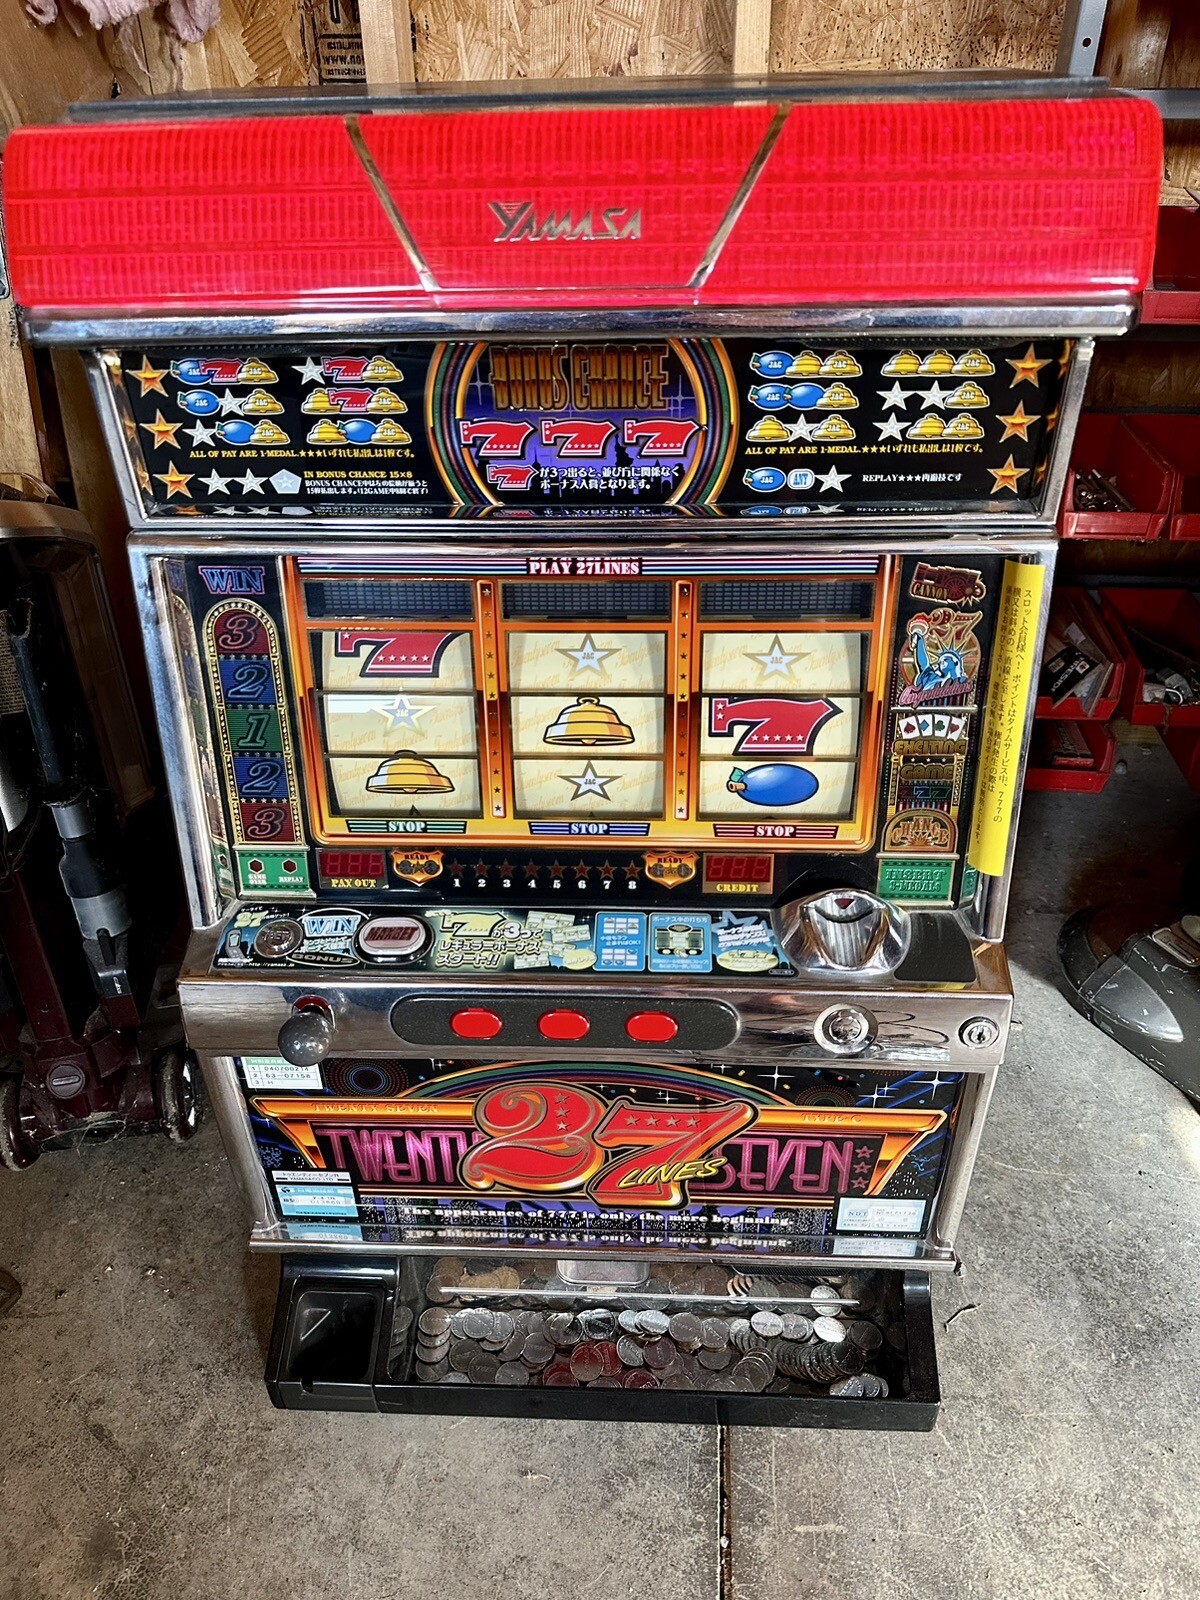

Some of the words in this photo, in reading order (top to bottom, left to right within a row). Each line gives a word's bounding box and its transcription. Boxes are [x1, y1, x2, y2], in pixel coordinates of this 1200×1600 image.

[487, 201, 643, 242] YAMASA
[768, 359, 783, 368] JAC
[833, 359, 848, 368] JAC
[966, 358, 981, 367] JAC
[249, 367, 262, 375] JAC
[374, 366, 388, 375] JAC
[490, 345, 568, 411] BONUS
[571, 345, 669, 411] CHANCE
[378, 397, 392, 406] JAC
[766, 393, 780, 401] JAC
[830, 392, 844, 401] JAC
[961, 392, 975, 400] JAC
[195, 398, 208, 407] JAC
[255, 398, 269, 407] JAC
[261, 429, 275, 437] JAC
[383, 428, 397, 437] JAC
[827, 424, 842, 432] JAC
[956, 423, 971, 432] JAC
[189, 450, 206, 458] ALL
[208, 450, 219, 458] OF
[221, 450, 237, 458] PAY
[240, 450, 259, 458] ARE
[744, 444, 763, 455] ALL
[766, 445, 778, 455] OF
[779, 445, 796, 454] PAY
[797, 445, 818, 454] ARE
[316, 471, 346, 479] BONUS
[349, 471, 387, 479] CHANCE
[760, 475, 774, 484] JAC
[793, 473, 808, 486] ANY
[862, 474, 898, 482] REPLAY
[529, 562, 572, 575] PLAY
[575, 562, 640, 575] 27LINES
[198, 565, 266, 594] WIN
[912, 582, 950, 600] CANNON
[930, 608, 983, 641] 27
[218, 613, 259, 651] 3
[227, 663, 268, 699] 2
[237, 713, 271, 747] 1
[708, 697, 844, 756] 7
[893, 740, 966, 755] EXCITING
[241, 760, 282, 794] 2
[900, 764, 953, 780] GAME
[246, 807, 286, 840] 3
[388, 821, 427, 833] STOP
[570, 823, 609, 834] STOP
[756, 825, 796, 836] STOP
[892, 817, 949, 844] CHANCE
[885, 868, 947, 880] INSERT
[331, 879, 352, 888] PAY
[355, 879, 377, 888] OUT
[453, 879, 461, 888] 1
[477, 879, 486, 888] 2
[503, 879, 511, 888] 3
[528, 880, 536, 889] 4
[553, 880, 561, 889] 5
[577, 880, 587, 889] 6
[603, 880, 612, 889] 7
[628, 881, 637, 890] 8
[716, 884, 759, 892] CREDIT
[303, 915, 361, 937] WIN
[364, 926, 419, 941] MAXBET
[440, 941, 541, 952] レギュラーボーナス
[292, 953, 354, 963] BONUS
[312, 1103, 379, 1113] TWENTY
[385, 1103, 440, 1113] SEVEN
[801, 1113, 863, 1123] TYPE-C
[458, 1080, 760, 1209] 27
[314, 1129, 484, 1185] TWENT
[618, 1156, 728, 1189] LINES
[401, 1207, 431, 1216] The
[435, 1208, 524, 1219] appearance
[527, 1208, 545, 1218] of
[583, 1211, 596, 1220] is
[600, 1212, 635, 1222] only
[640, 1212, 664, 1221] the
[668, 1214, 709, 1223] mere
[712, 1214, 794, 1225] beginning.
